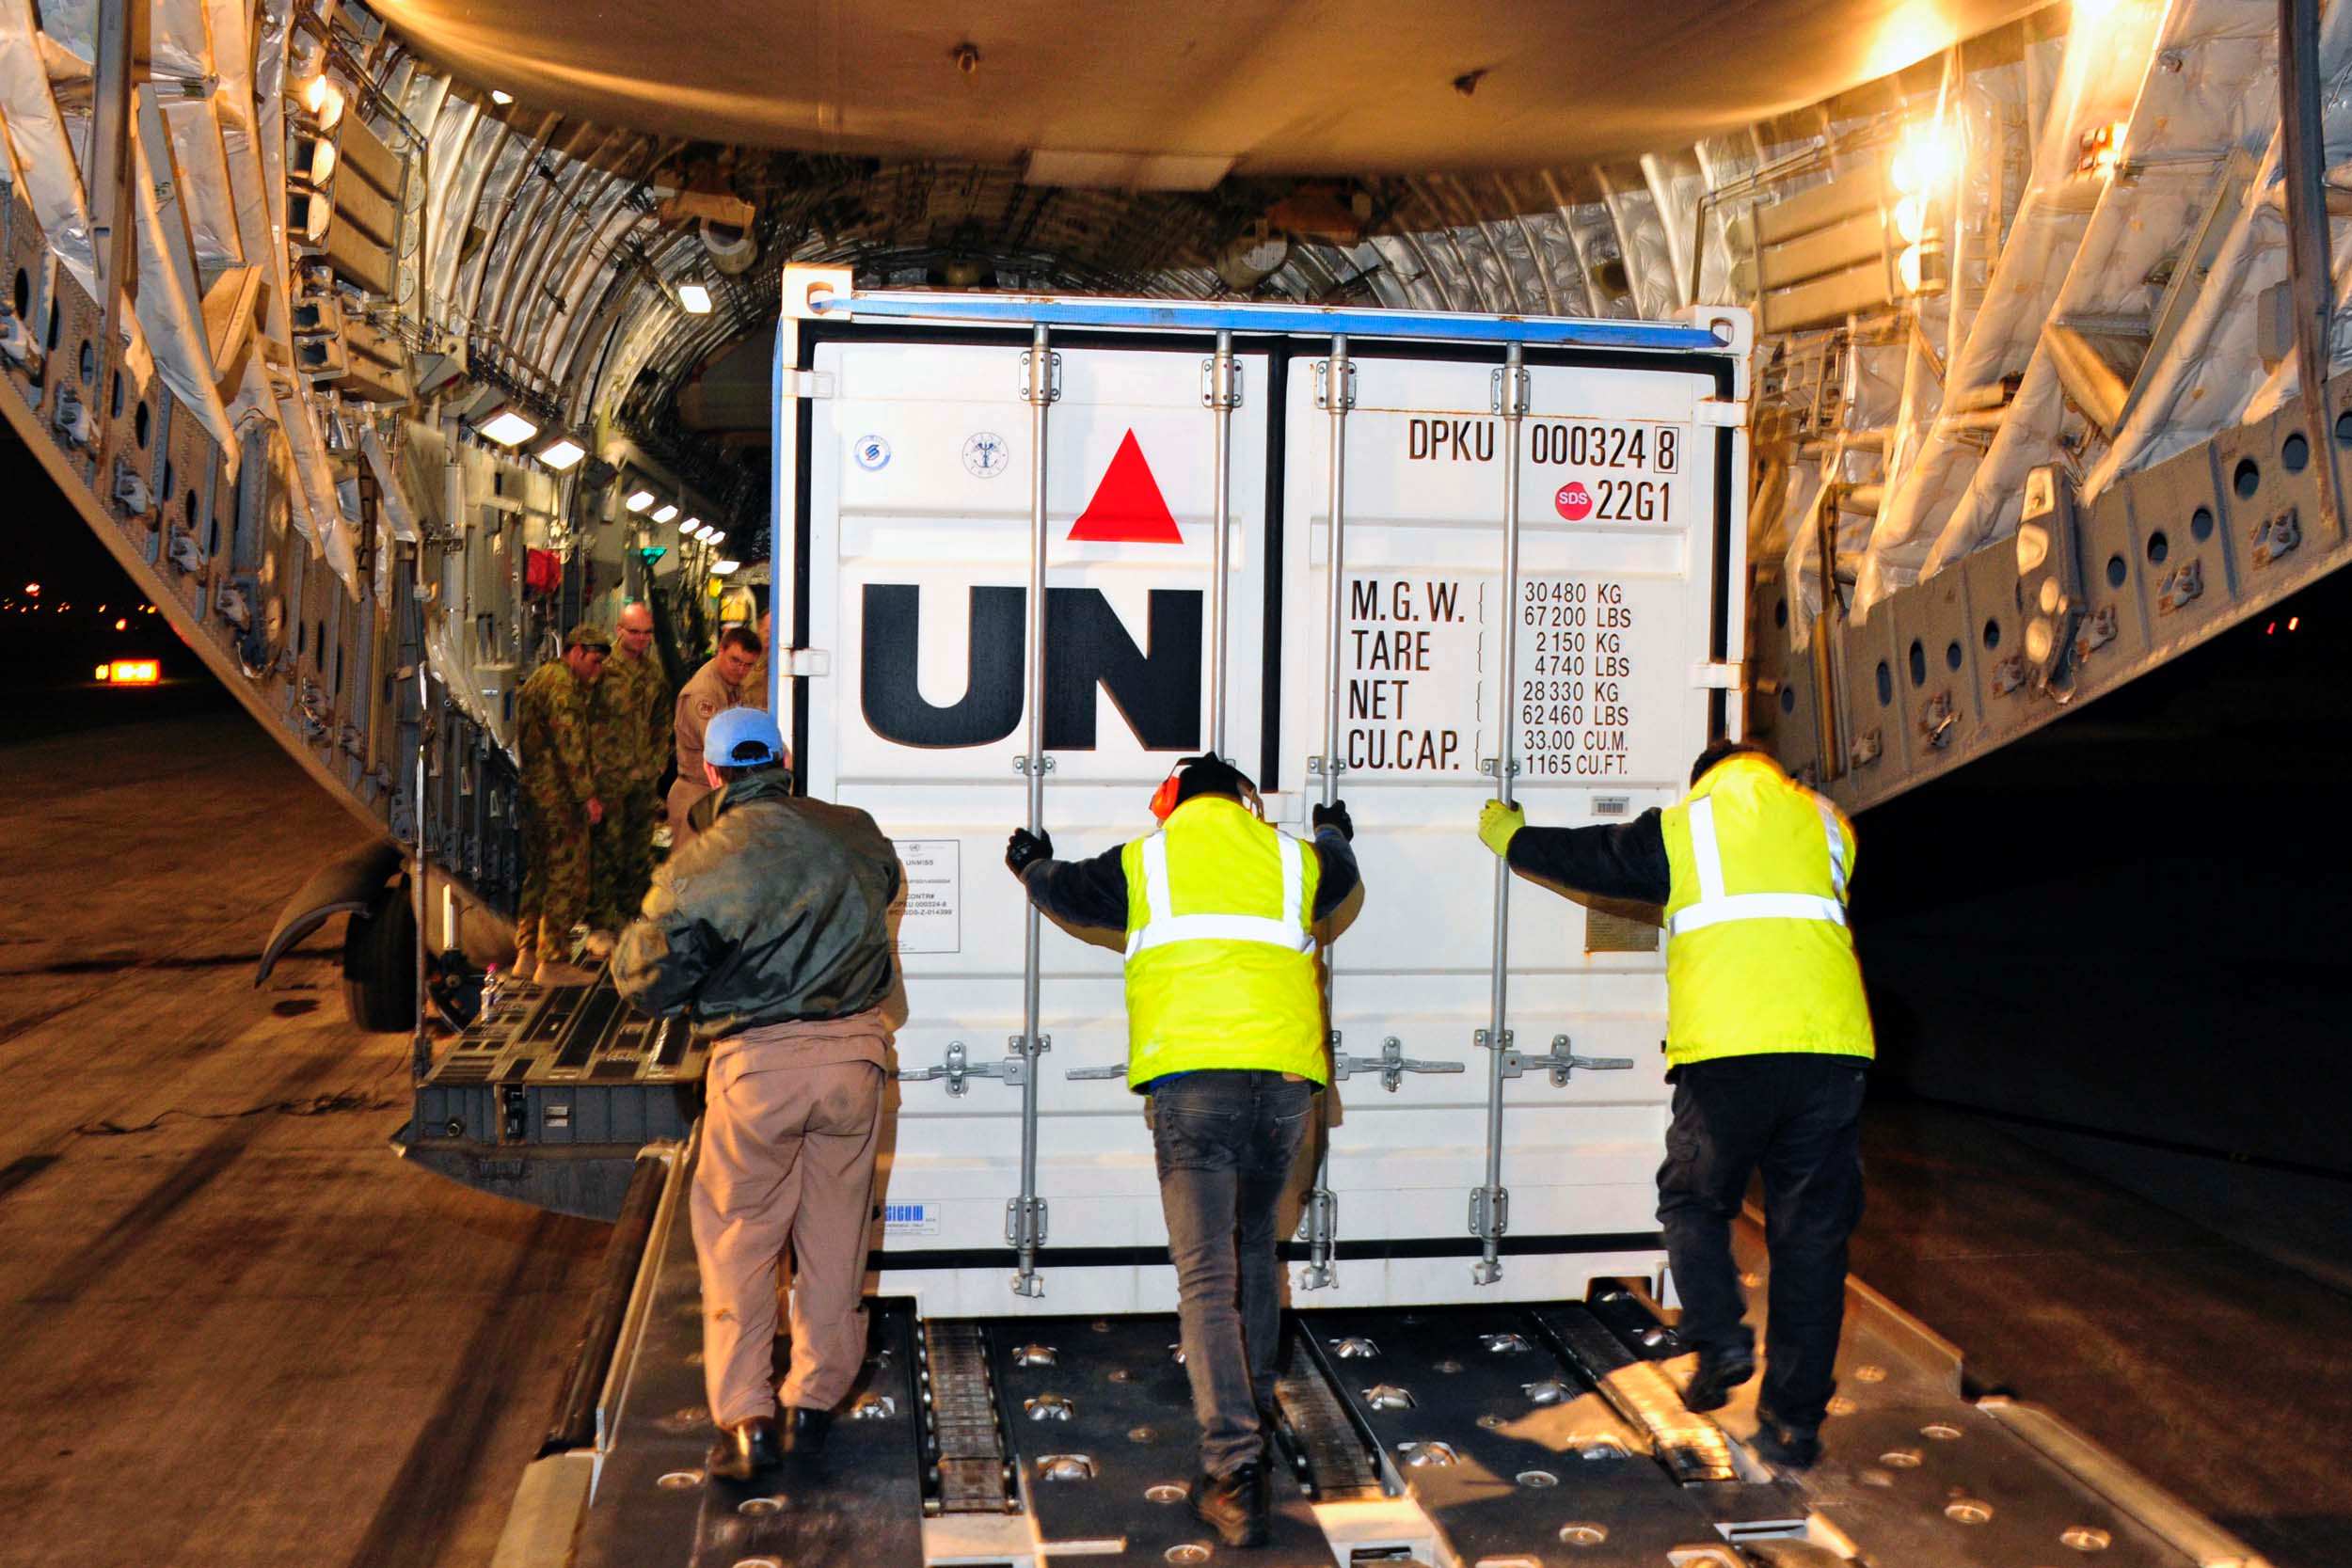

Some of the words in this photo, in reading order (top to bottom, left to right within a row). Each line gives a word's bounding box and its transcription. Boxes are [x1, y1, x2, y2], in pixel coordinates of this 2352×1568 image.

[1409, 420, 1494, 461] DPKU
[1532, 424, 1646, 468] 000324
[1658, 430, 1675, 470] 8
[1559, 491, 1588, 505] SDS
[1596, 480, 1670, 522] 22G1
[1597, 583, 1622, 604] KG
[1597, 607, 1631, 628] LBS
[1351, 629, 1430, 671] TARE
[1596, 632, 1620, 654] KG
[861, 583, 1203, 752] UN
[1595, 656, 1630, 677] LBS
[1349, 679, 1409, 720] NET
[1594, 681, 1619, 703] KG
[1594, 705, 1629, 726] LBS
[1348, 729, 1460, 769] CU.CAP.
[1524, 730, 1575, 751] 33,00
[1583, 730, 1629, 751] CU.M.
[1526, 753, 1571, 774] 1165
[1576, 754, 1628, 775] CU.FT.
